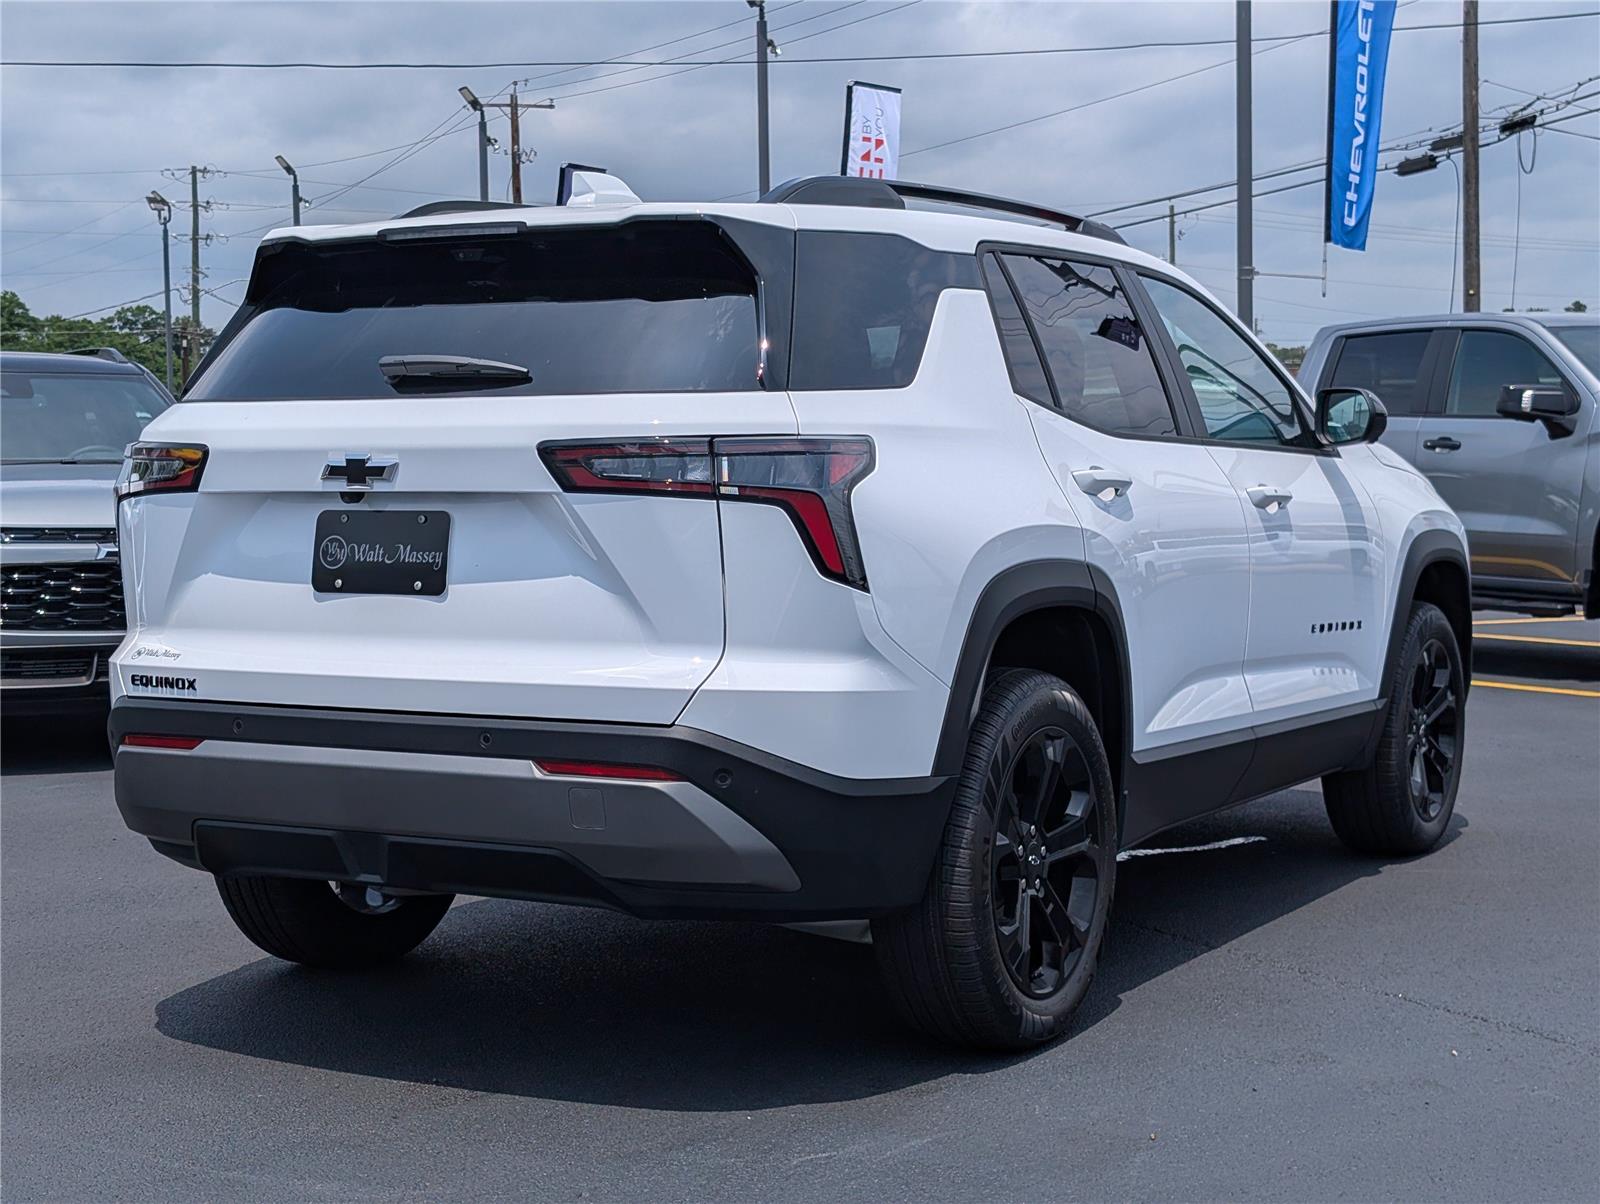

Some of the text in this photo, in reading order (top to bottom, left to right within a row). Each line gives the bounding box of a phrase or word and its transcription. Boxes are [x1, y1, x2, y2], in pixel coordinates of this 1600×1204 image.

[874, 106, 885, 137] YOU
[1343, 0, 1375, 227] CHEVROLET
[861, 116, 872, 135] BY
[347, 543, 384, 563] Walt
[384, 544, 443, 571] Massey
[1311, 620, 1362, 634] EQUINOX
[130, 673, 197, 691] EQUINOX
